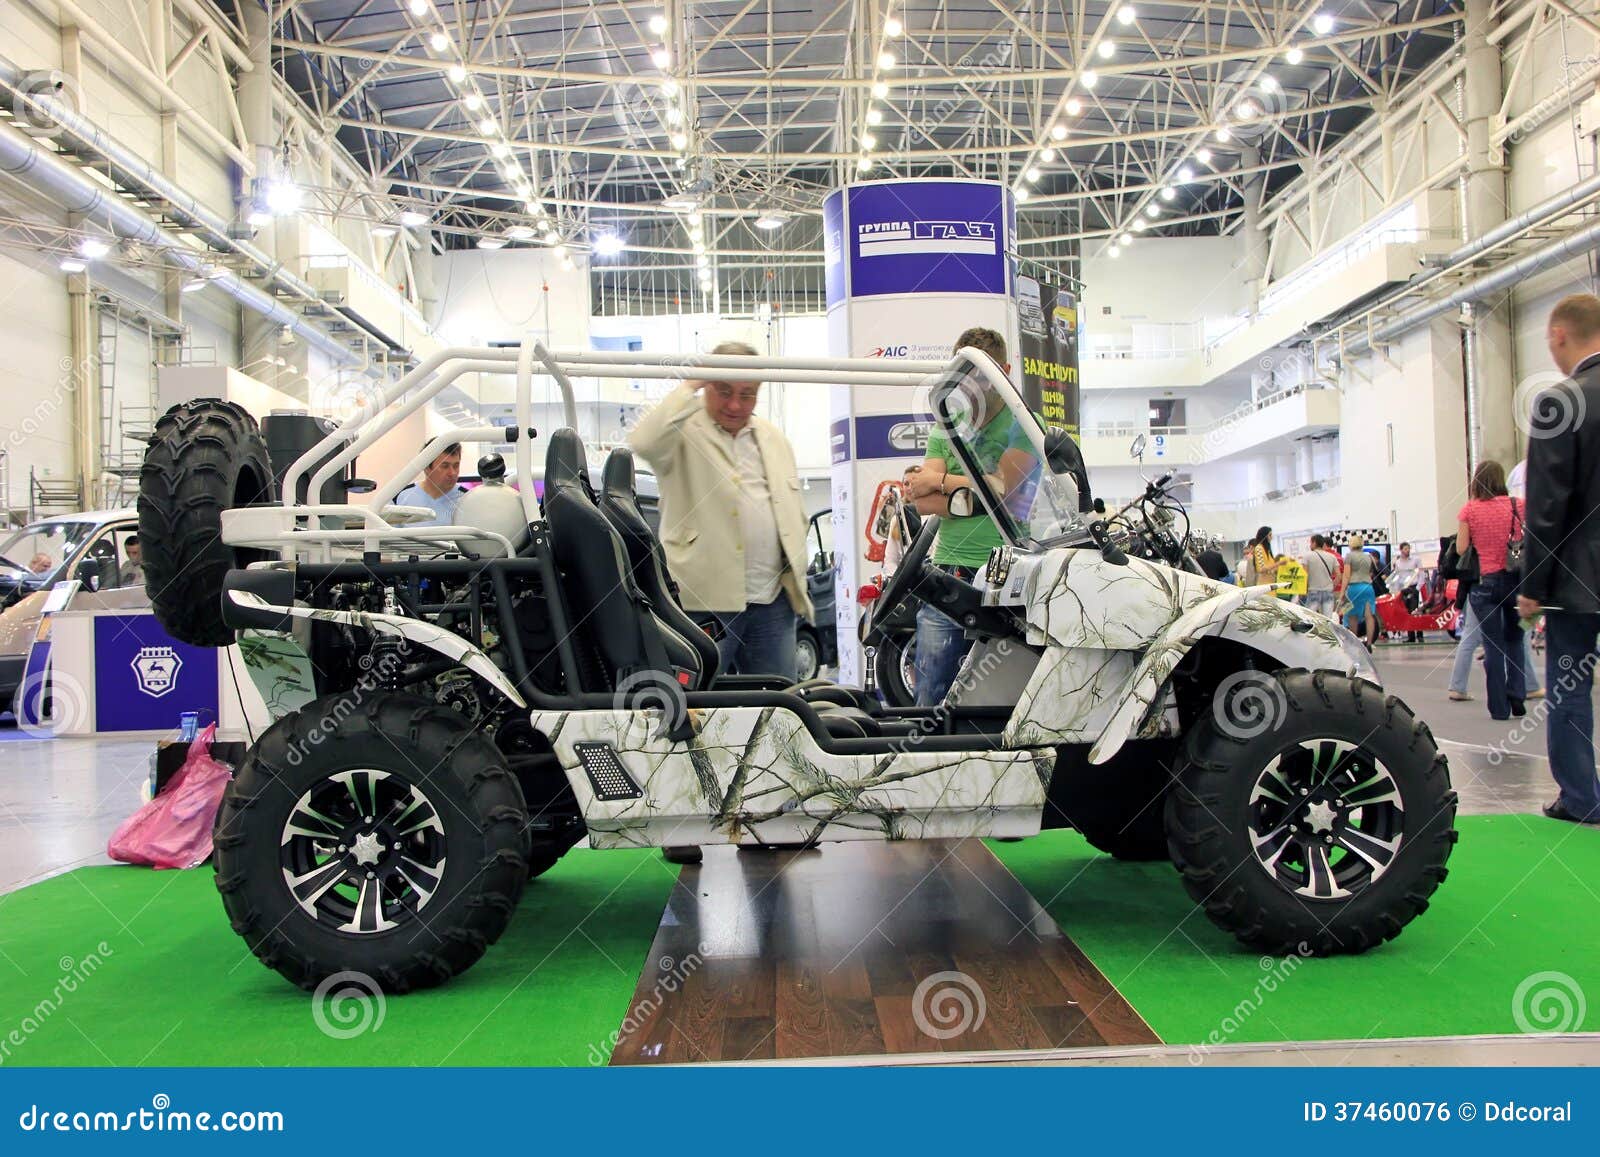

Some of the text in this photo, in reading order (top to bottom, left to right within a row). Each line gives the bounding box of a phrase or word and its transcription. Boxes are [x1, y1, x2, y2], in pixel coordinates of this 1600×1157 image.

[858, 221, 912, 234] ГРУППА
[883, 345, 908, 358] AIC
[1155, 435, 1164, 447] 9
